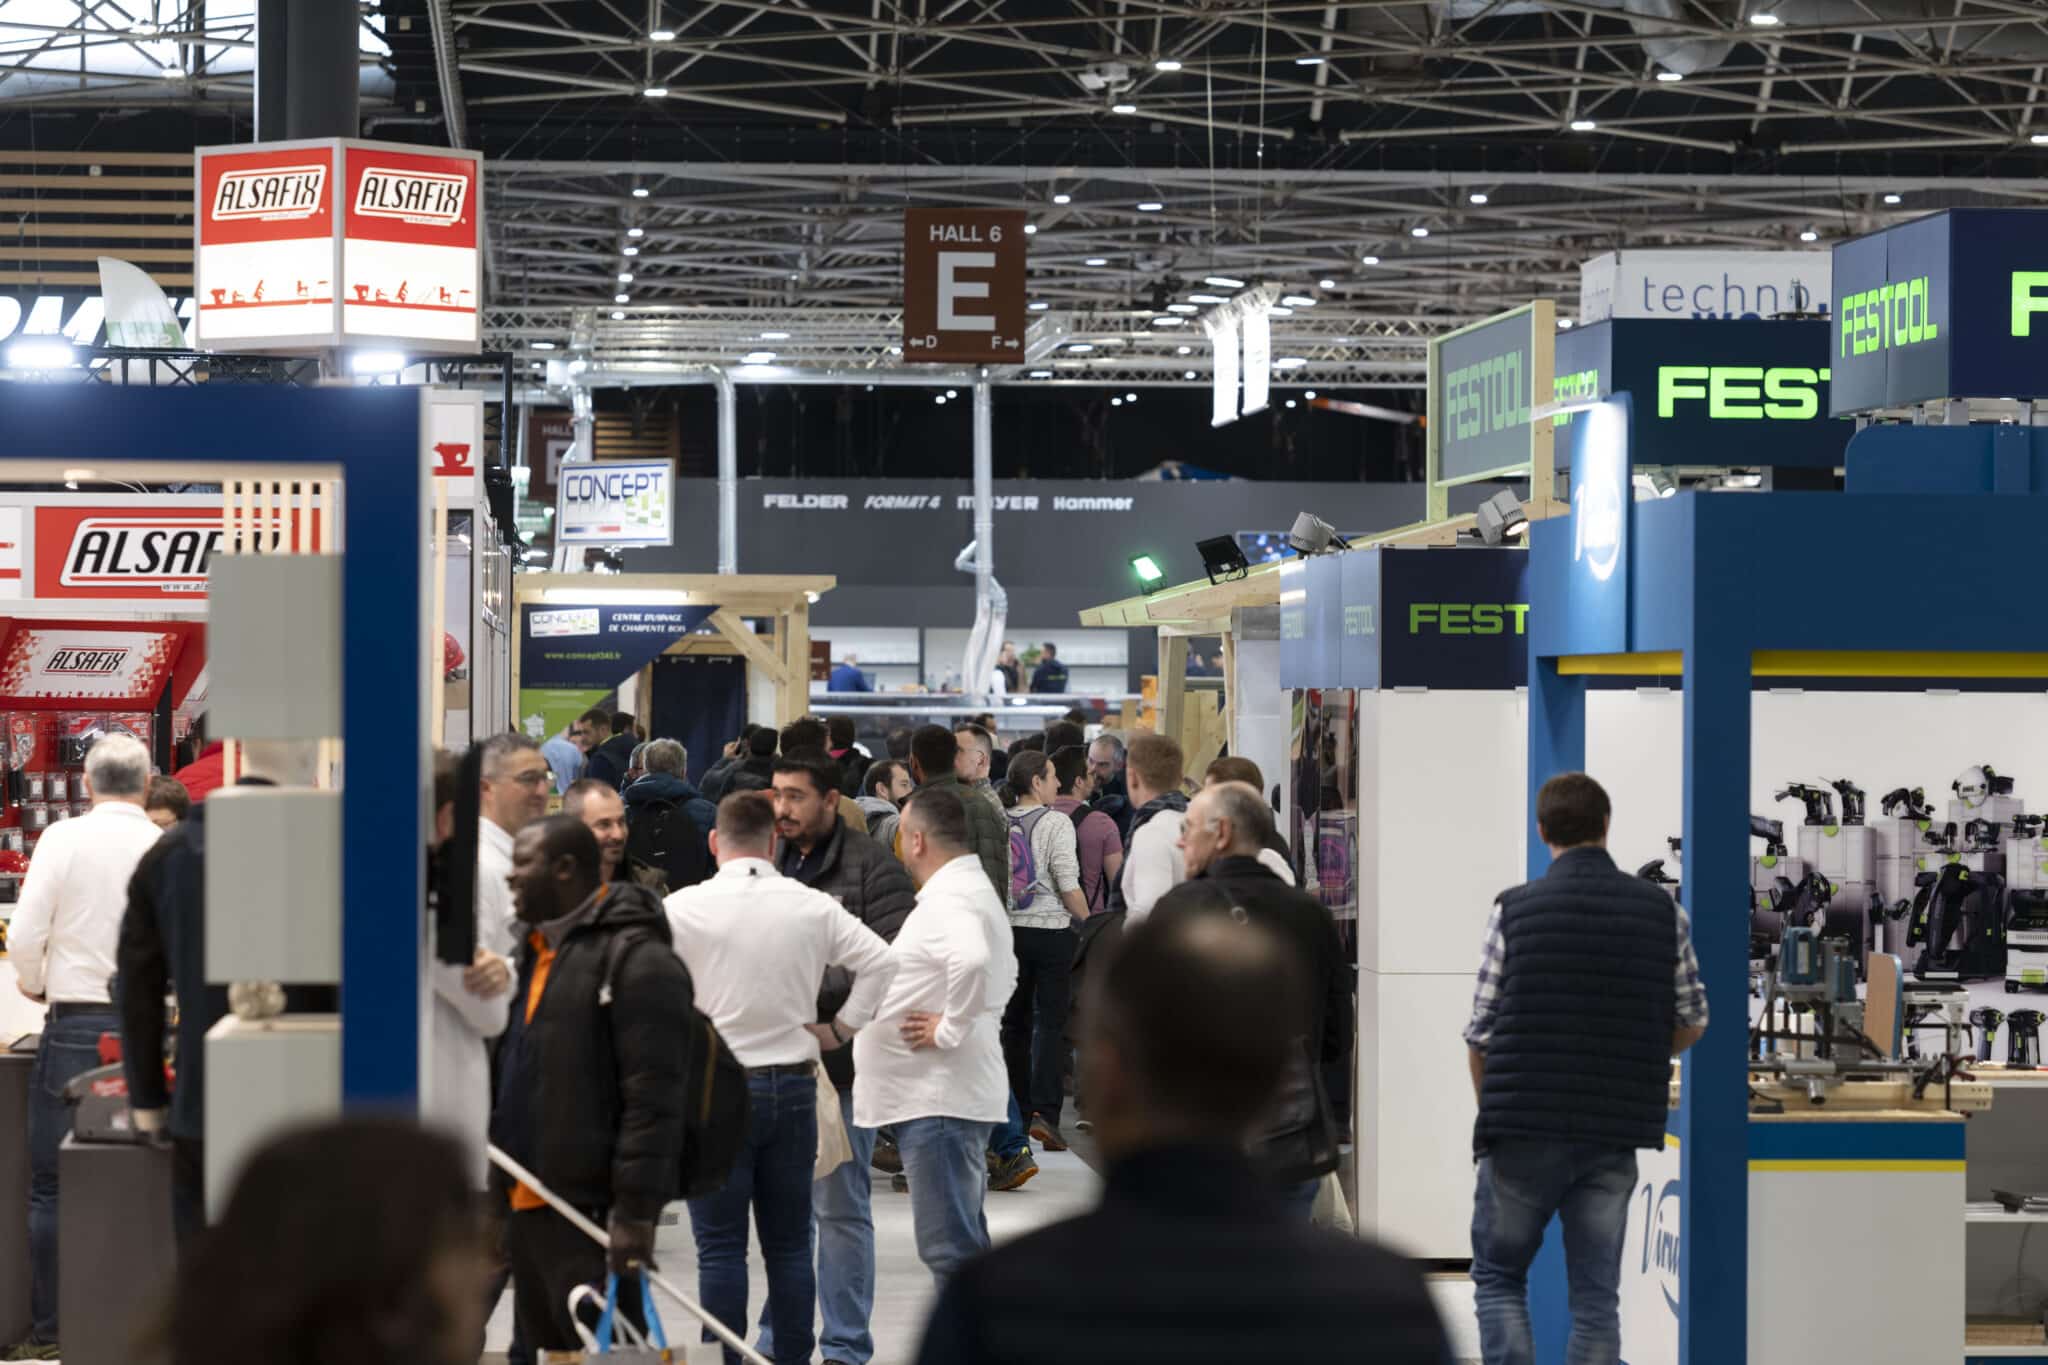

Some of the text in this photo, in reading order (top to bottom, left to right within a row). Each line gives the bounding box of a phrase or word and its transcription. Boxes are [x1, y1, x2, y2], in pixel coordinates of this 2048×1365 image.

[929, 225, 1002, 243] HALL 6
[937, 252, 996, 331] E
[1841, 276, 1938, 358] FESTOOL
[926, 335, 1002, 349] D F
[1446, 350, 1530, 443] FESTOOL
[1658, 366, 1831, 420] FES
[566, 472, 663, 502] CONCEPT
[763, 494, 848, 509] FELDER
[72, 531, 280, 573] ALSAF
